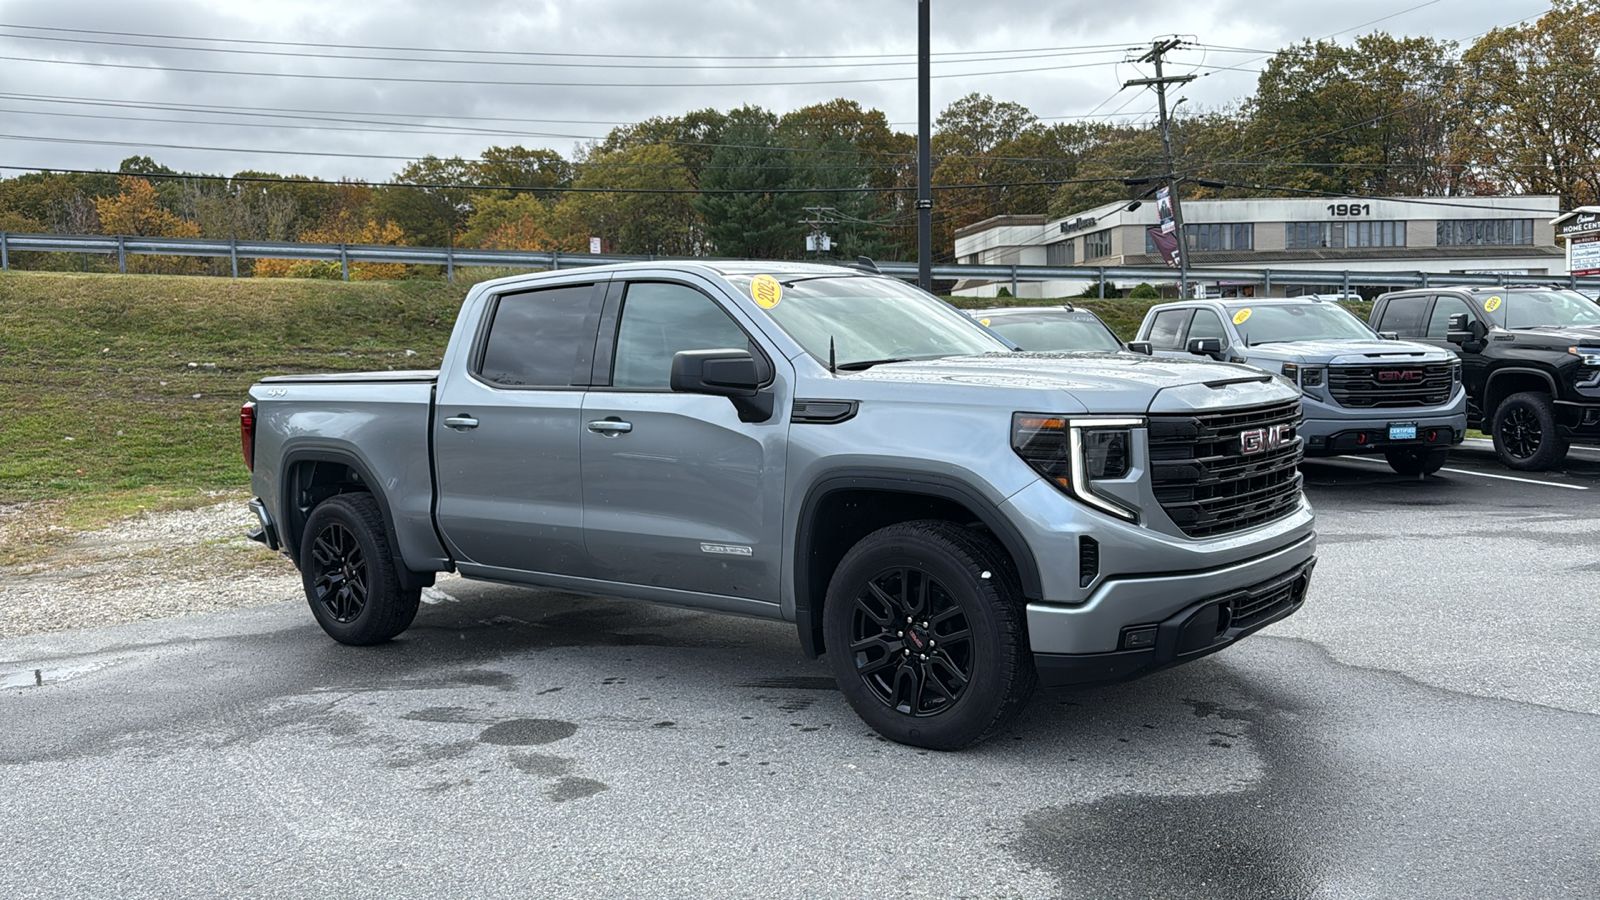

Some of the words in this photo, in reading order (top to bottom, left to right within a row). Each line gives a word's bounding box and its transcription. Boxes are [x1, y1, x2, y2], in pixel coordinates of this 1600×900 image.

[1327, 204, 1370, 216] 1961
[1563, 224, 1582, 233] HOME
[757, 277, 775, 304] 2024
[1379, 370, 1423, 380] GMC
[1241, 425, 1290, 455] GMC
